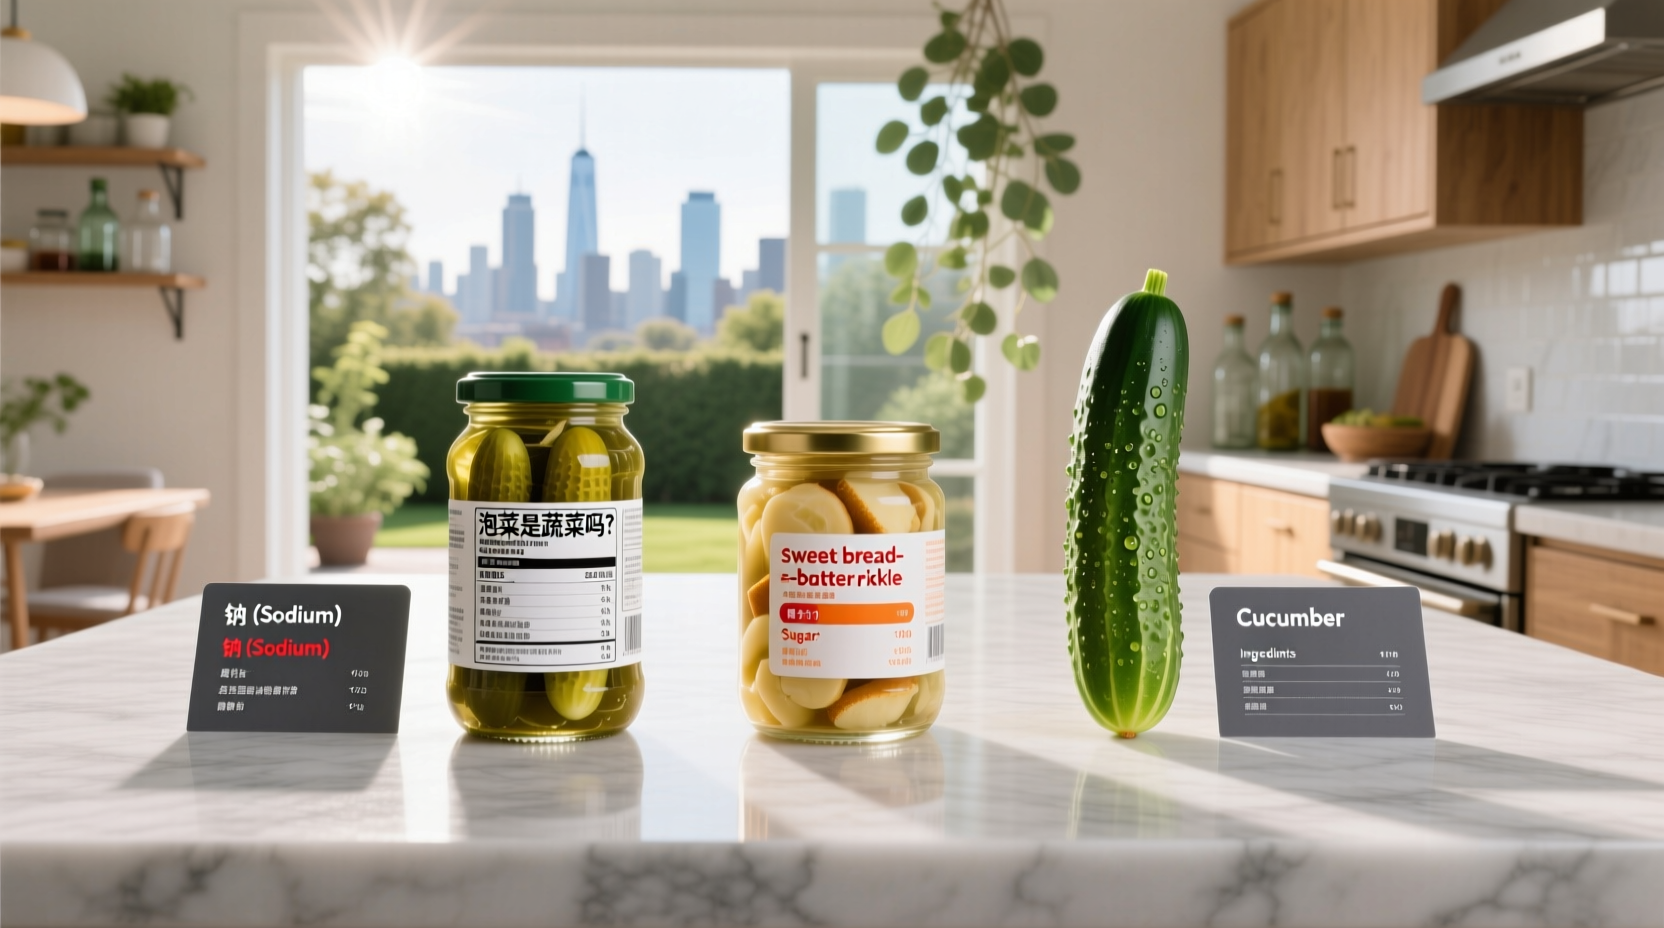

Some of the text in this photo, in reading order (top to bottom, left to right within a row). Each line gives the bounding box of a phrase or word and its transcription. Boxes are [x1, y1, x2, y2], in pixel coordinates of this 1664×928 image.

[781, 546, 904, 564] Sweet bread-
[225, 603, 342, 627] 钠 (Sodium)
[1236, 607, 1345, 627] Cucumber
[246, 638, 330, 660] (Sodium)
